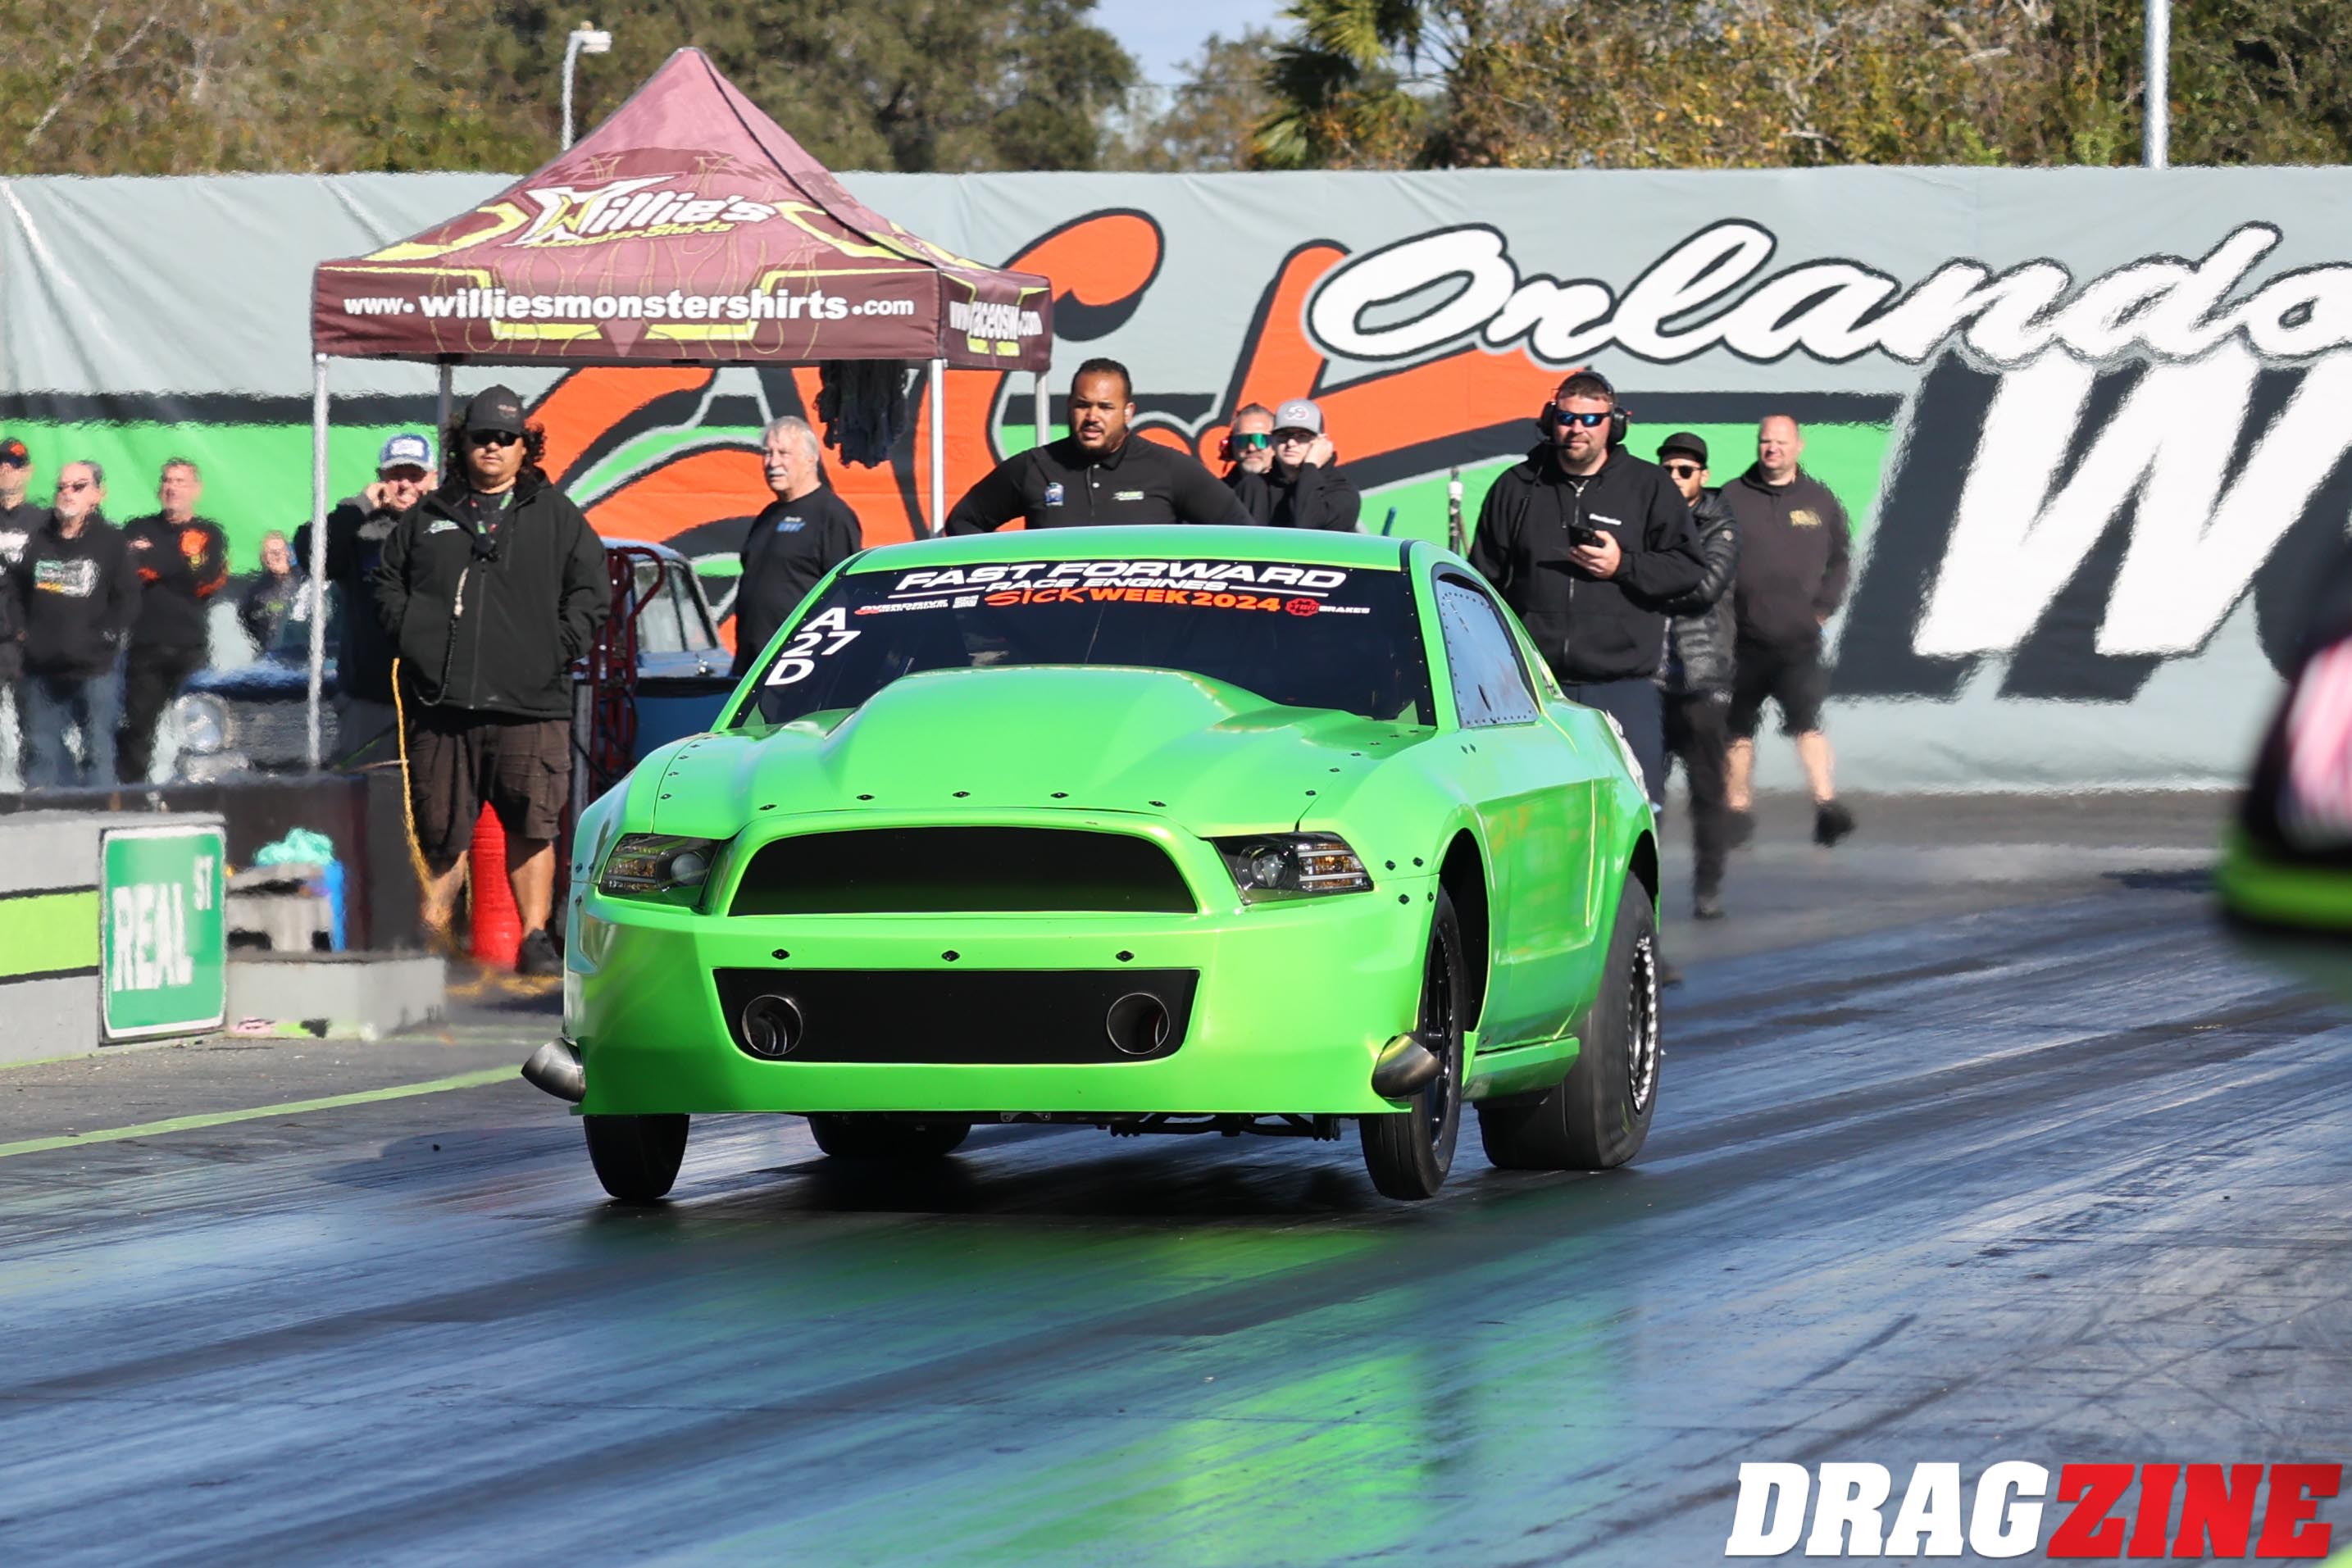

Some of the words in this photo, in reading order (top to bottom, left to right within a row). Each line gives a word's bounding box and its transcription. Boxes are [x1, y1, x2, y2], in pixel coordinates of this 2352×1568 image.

[502, 175, 776, 248] Willie's
[1309, 216, 2352, 366] Orlando
[895, 566, 1045, 591] FAST
[1046, 561, 1347, 589] FORWARD
[985, 579, 1076, 593] RACE
[1085, 577, 1229, 592] ENGINES
[1090, 589, 1190, 607] WEEK
[1190, 591, 1281, 612] 2024
[1318, 605, 1371, 614] BRAKES
[801, 607, 846, 632] A
[781, 630, 862, 657] 27
[764, 658, 815, 686] D
[112, 883, 193, 992] REAL
[193, 856, 213, 911] ST
